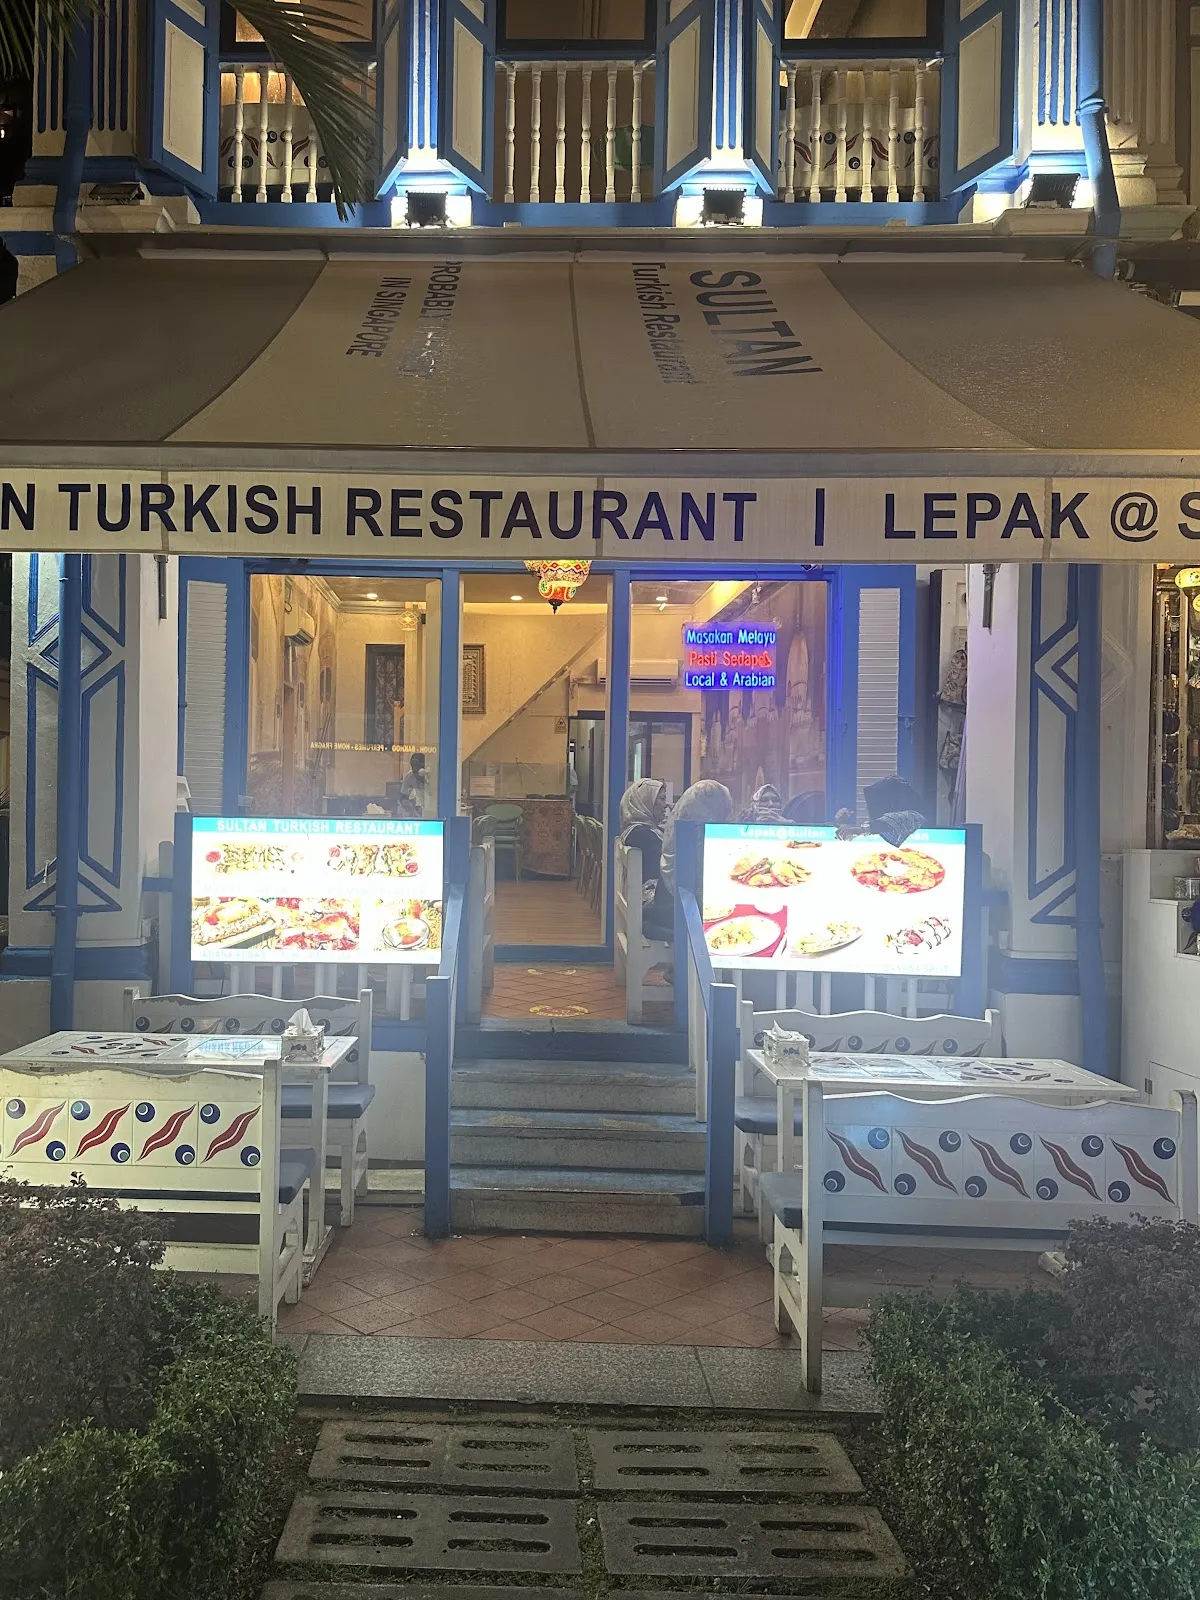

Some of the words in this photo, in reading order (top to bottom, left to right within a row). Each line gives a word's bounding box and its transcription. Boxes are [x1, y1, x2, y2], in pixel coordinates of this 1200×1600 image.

[380, 277, 412, 289] IN
[631, 262, 676, 310] Turkish
[345, 290, 408, 358] SINGAPORE
[689, 269, 824, 377] SULTAN
[58, 483, 322, 535] TURKISH
[346, 487, 757, 542] RESTAURANT
[884, 491, 1090, 540] LEPAK
[1110, 491, 1159, 542] @
[686, 629, 733, 644] Masakan
[737, 628, 776, 648] Melayu
[689, 650, 718, 667] Pasti
[722, 650, 758, 670] Sedap
[685, 671, 715, 687] Local
[720, 671, 728, 687] &
[733, 671, 775, 687] Arabian
[216, 819, 267, 832] SULTAN
[273, 820, 330, 833] TURKISH
[335, 821, 421, 835] RESTAURANT
